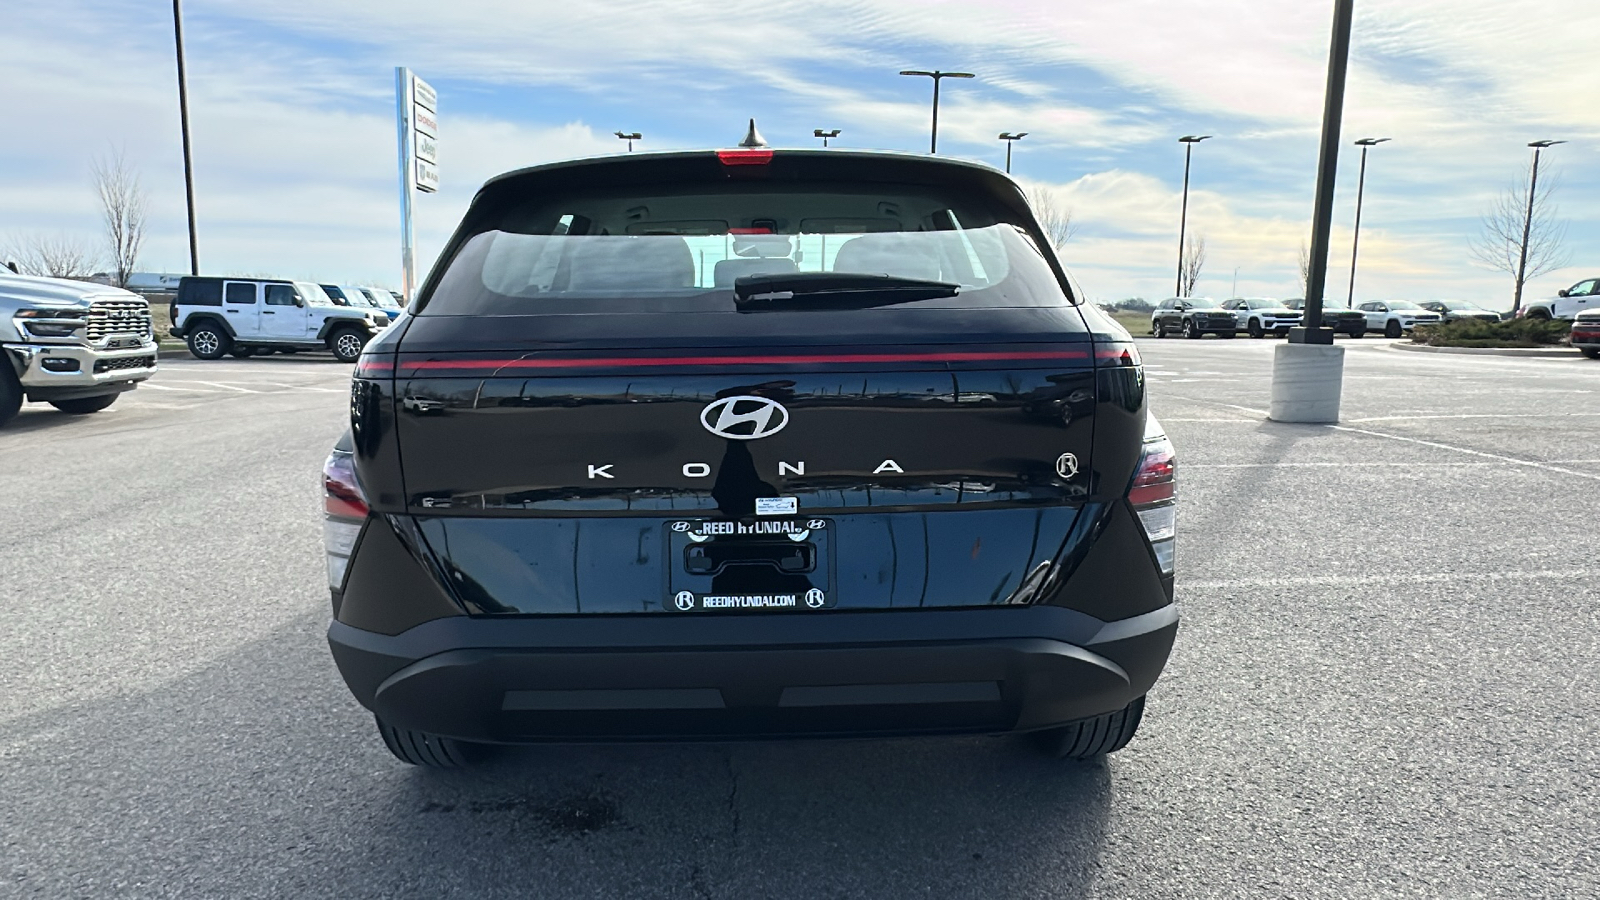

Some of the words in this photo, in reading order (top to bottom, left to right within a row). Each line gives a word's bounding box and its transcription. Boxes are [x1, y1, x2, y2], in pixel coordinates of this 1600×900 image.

[587, 459, 905, 479] KONA
[703, 522, 734, 534] REED
[703, 595, 796, 608] REEDHYUNDAI.COM
